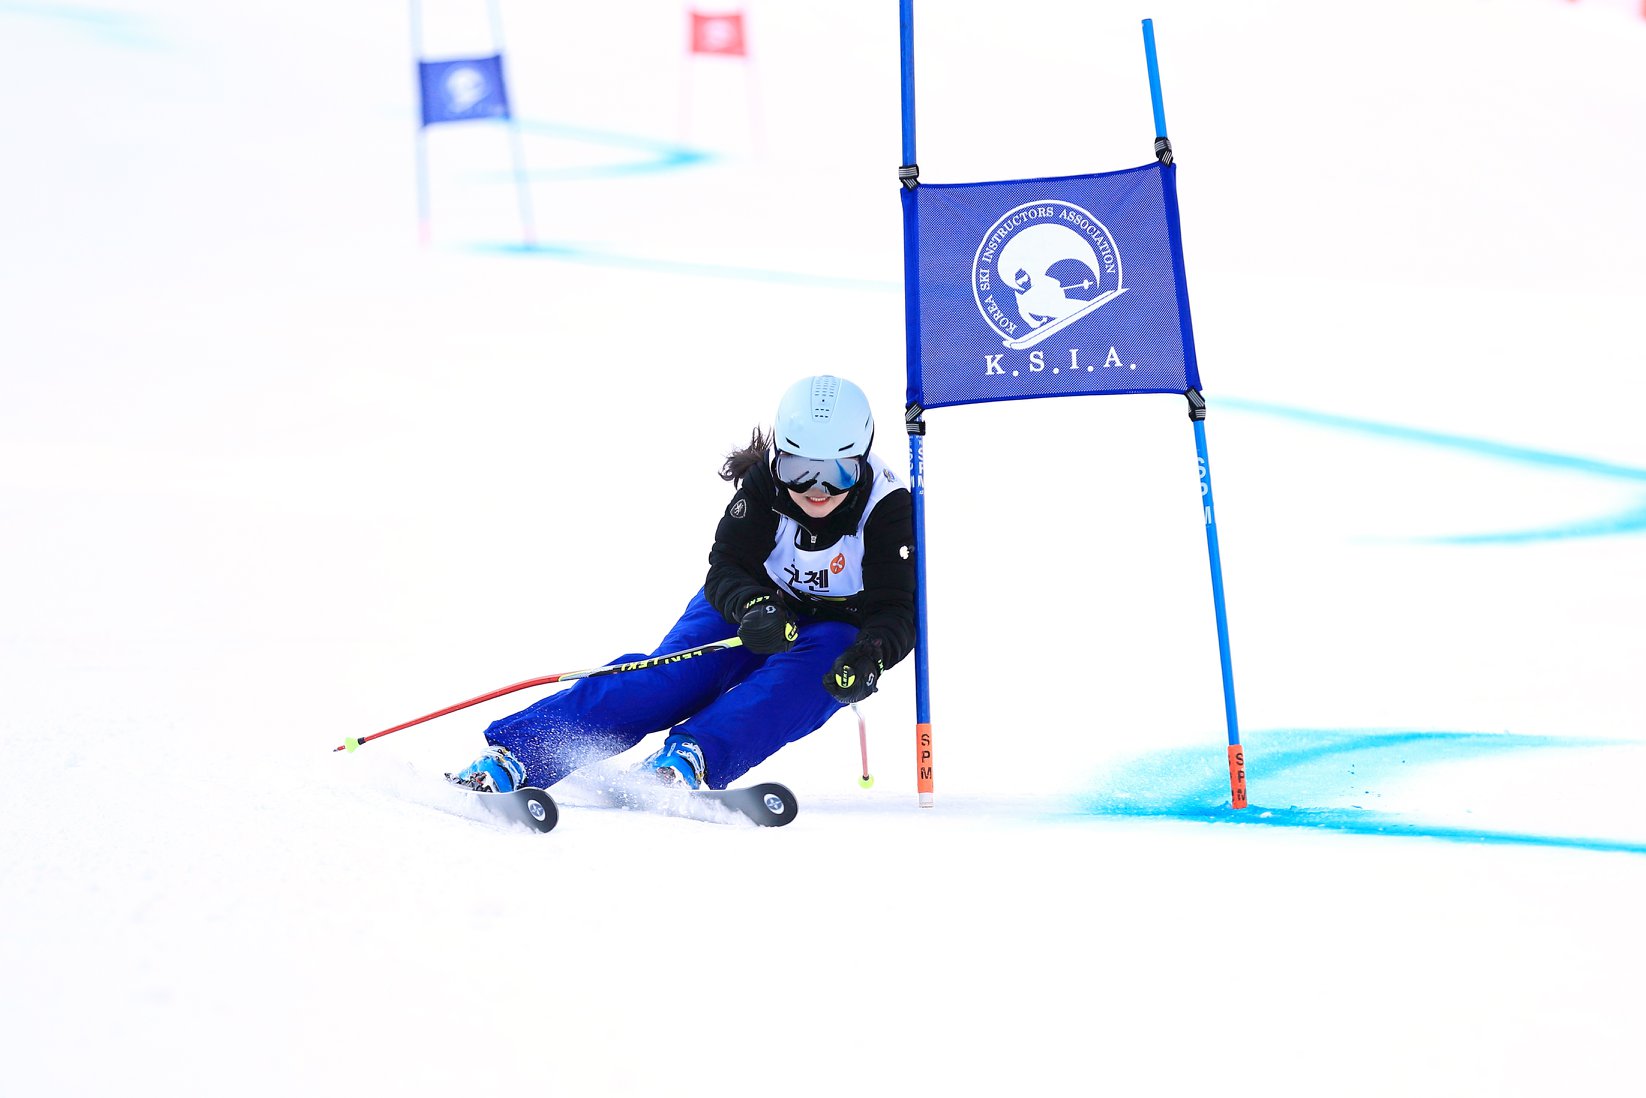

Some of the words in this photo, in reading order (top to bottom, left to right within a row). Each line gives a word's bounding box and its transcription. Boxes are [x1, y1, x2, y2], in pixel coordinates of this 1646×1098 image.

[982, 207, 1054, 264] INSTRUCTORS
[1059, 209, 1116, 273] ASSOCIATION
[980, 268, 990, 290] SKI
[985, 294, 1018, 334] KOREA
[920, 733, 932, 780] SPM
